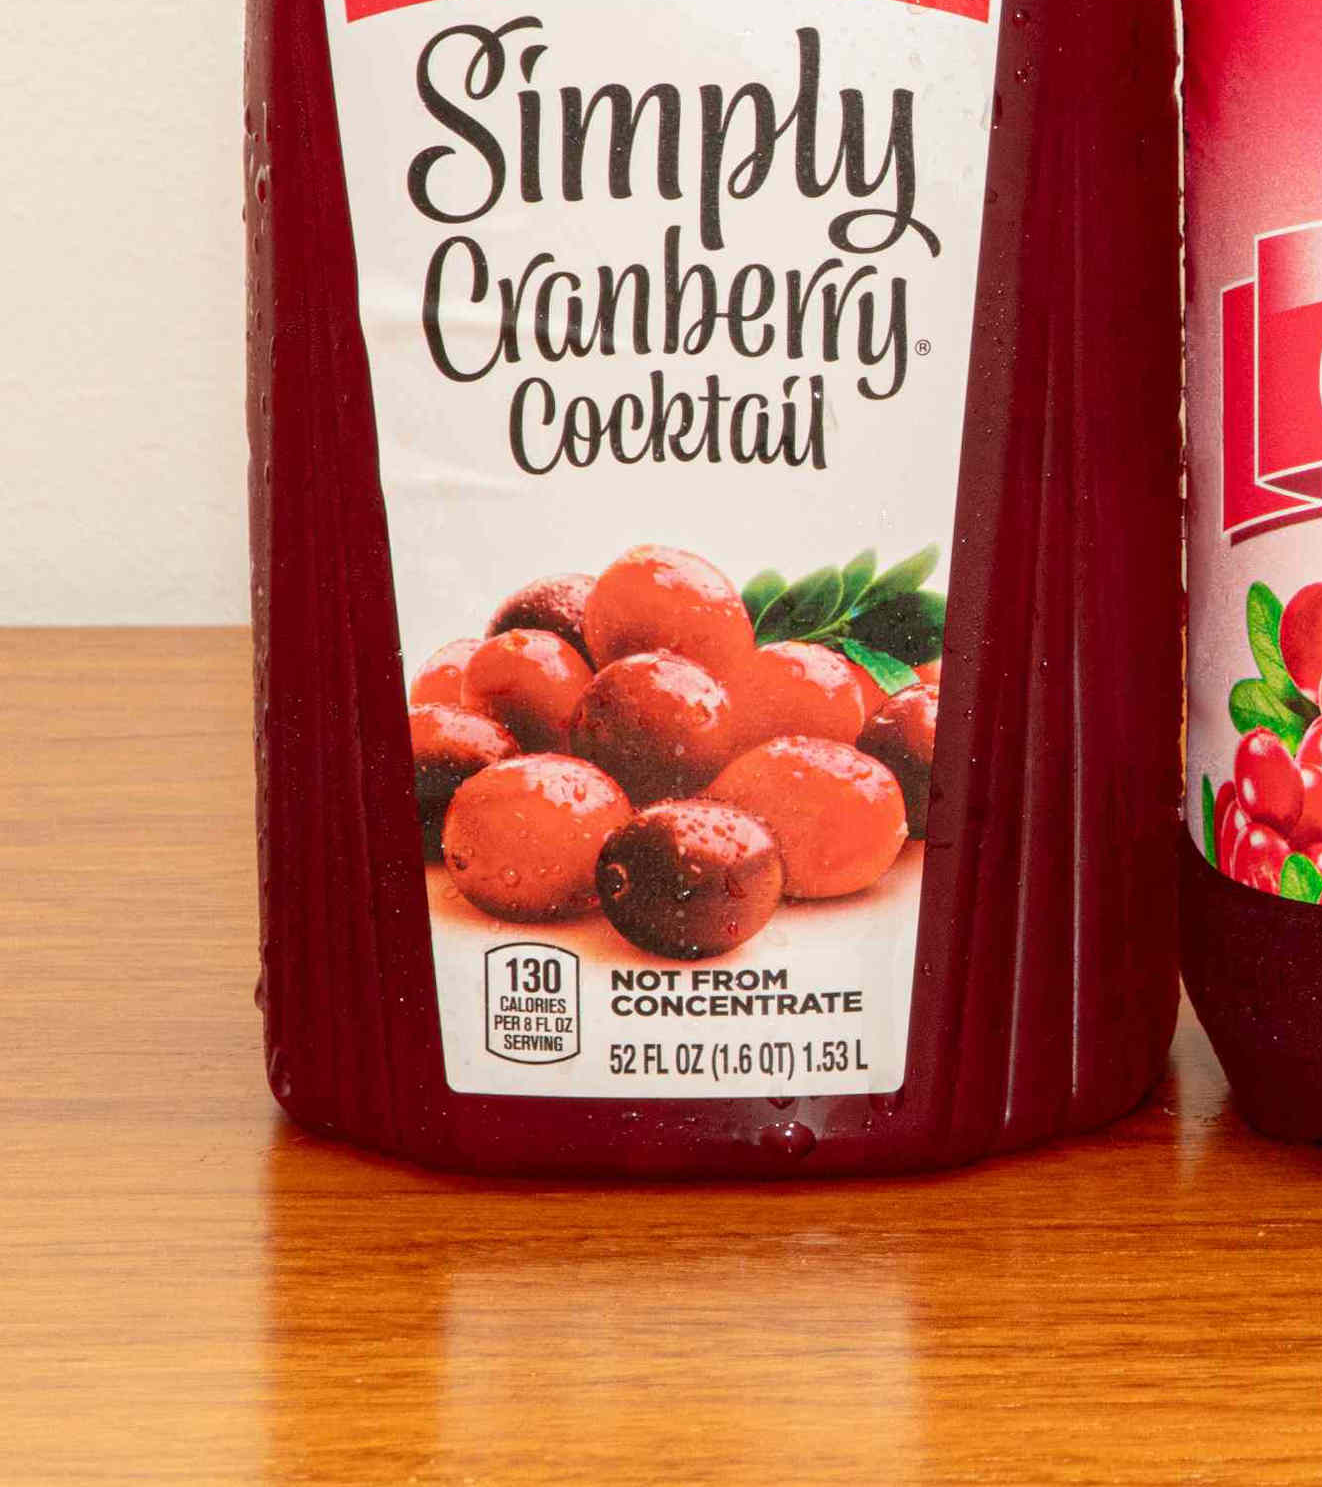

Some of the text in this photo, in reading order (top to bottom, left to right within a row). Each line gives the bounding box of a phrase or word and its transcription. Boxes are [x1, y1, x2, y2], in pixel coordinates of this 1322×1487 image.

[407, 16, 942, 258] Simply
[422, 225, 909, 401] Cranberry
[509, 368, 828, 475] Cocktail
[505, 958, 562, 995] 130
[611, 969, 789, 991] NOT FROM
[499, 997, 567, 1014] CALORIES
[610, 991, 864, 1017] CONCENTRATE
[494, 1015, 574, 1034] PER 8 FL OZ
[503, 1034, 564, 1053] SERVING
[609, 1039, 868, 1082] 52 FL OZ (1.6 QT) 1.53 L
